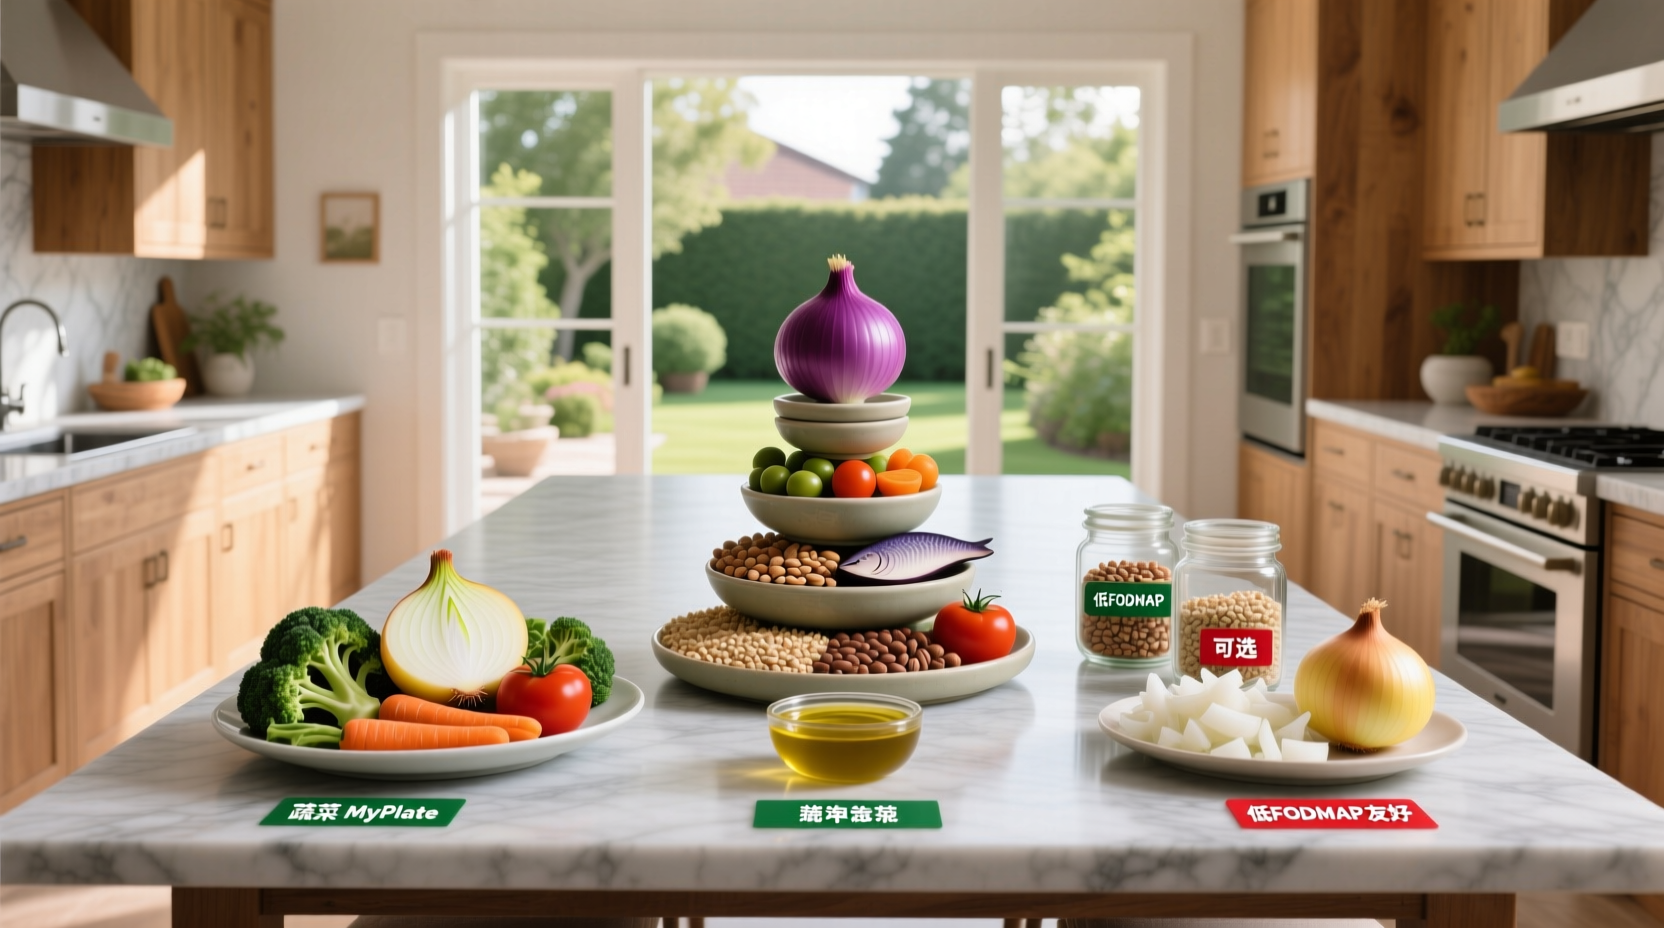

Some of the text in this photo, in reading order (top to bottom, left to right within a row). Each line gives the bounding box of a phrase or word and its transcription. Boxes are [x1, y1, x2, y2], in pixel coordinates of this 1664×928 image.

[1213, 636, 1258, 659] 可选
[287, 802, 439, 823] 蔬菜 MyPlate
[1247, 803, 1412, 822] 低FODMAP 友好
